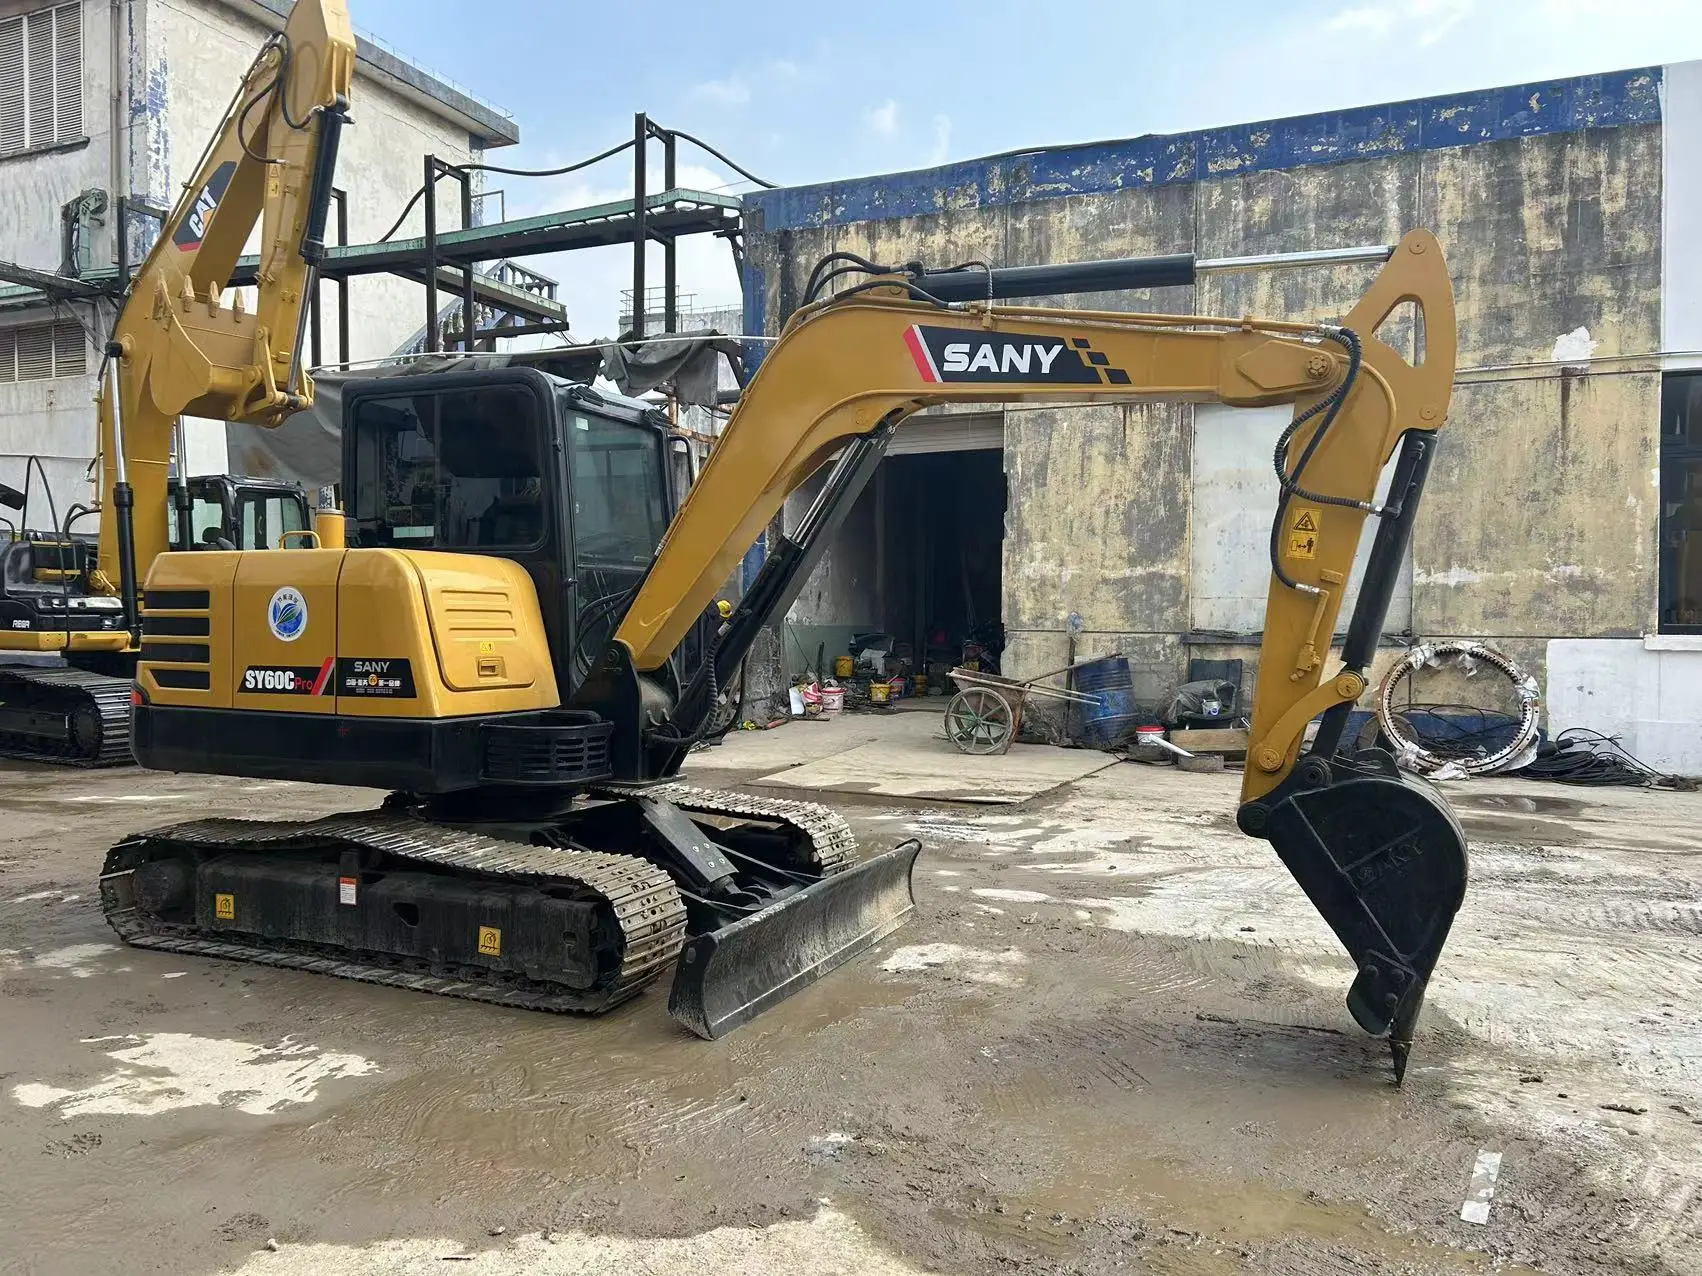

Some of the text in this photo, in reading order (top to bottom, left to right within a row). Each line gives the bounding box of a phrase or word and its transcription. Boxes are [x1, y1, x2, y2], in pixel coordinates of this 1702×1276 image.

[189, 185, 217, 238] CAT
[943, 343, 1064, 374] SANY
[245, 669, 295, 690] SY60C
[354, 661, 390, 673] SANY
